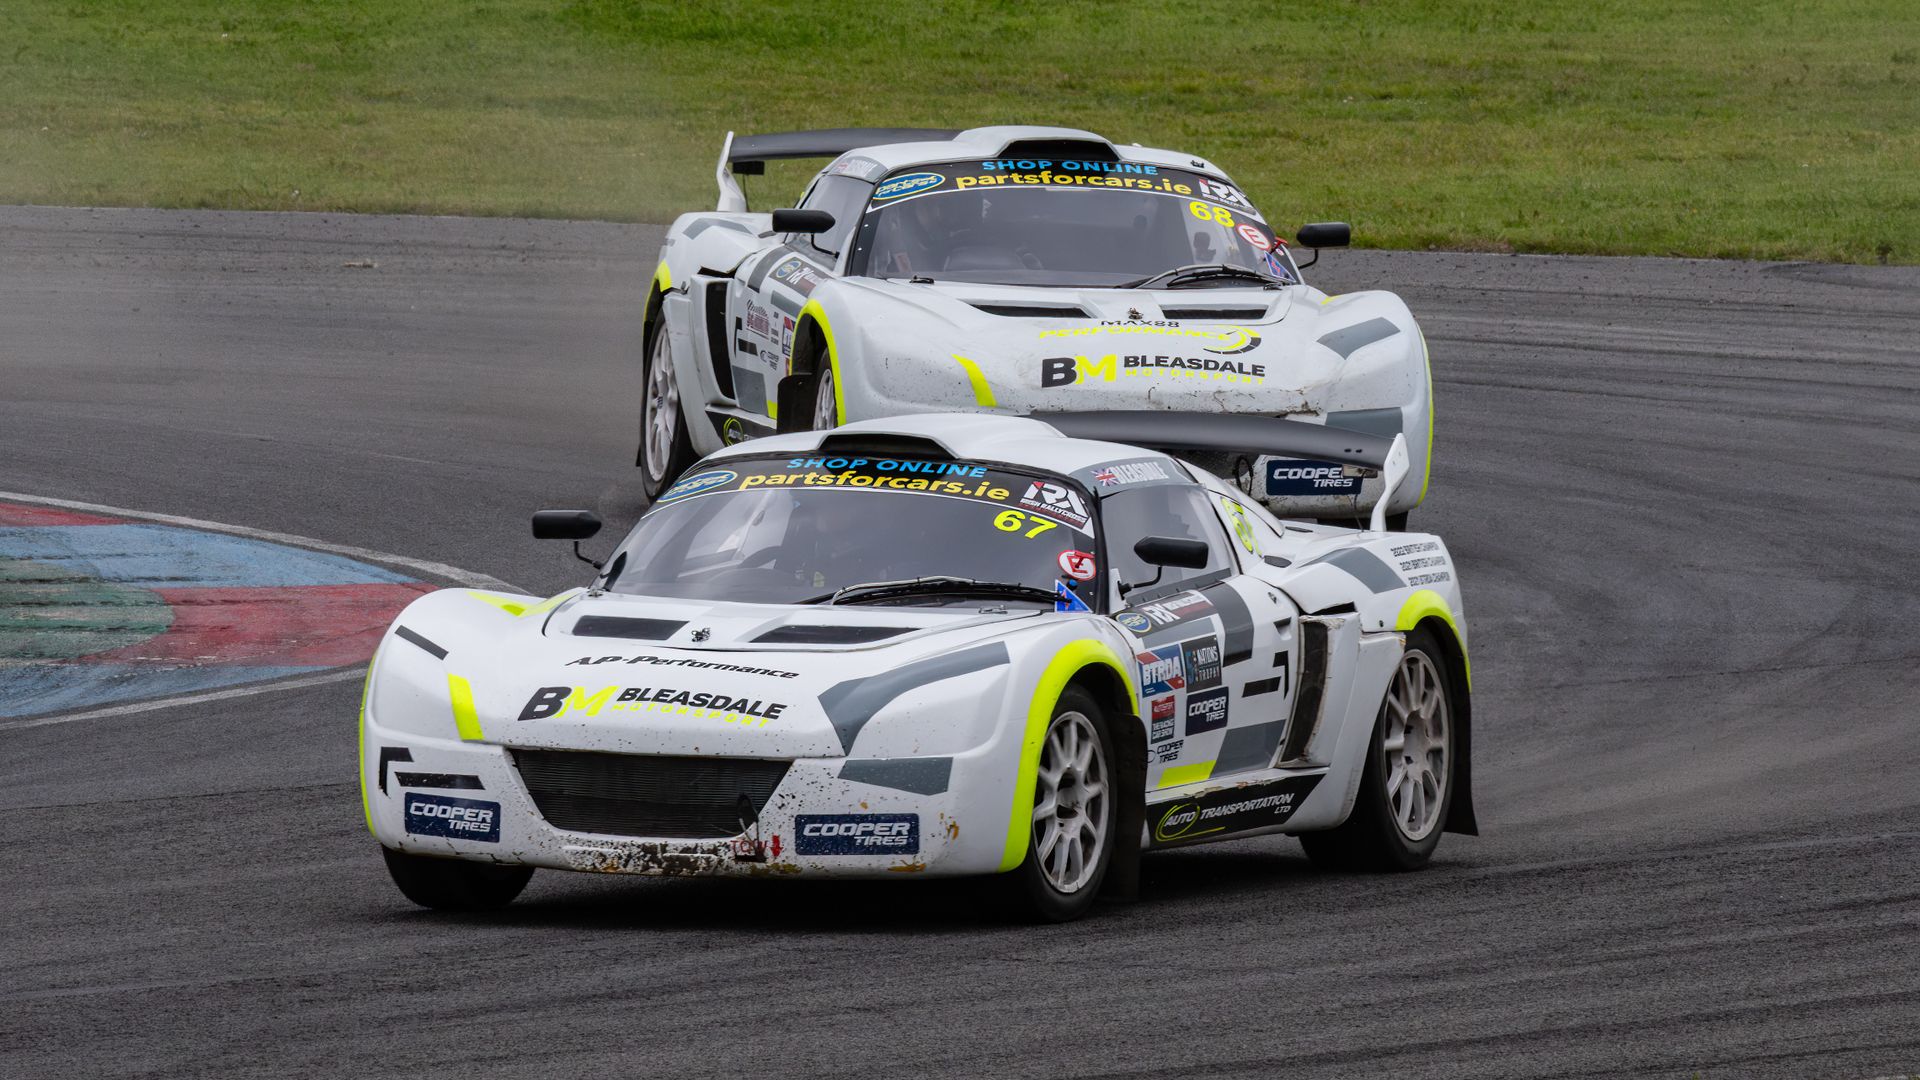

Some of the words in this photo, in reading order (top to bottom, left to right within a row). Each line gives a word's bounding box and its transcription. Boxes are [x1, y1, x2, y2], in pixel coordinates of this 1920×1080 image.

[982, 160, 1052, 171] SHOP
[1061, 161, 1159, 176] ONLINE
[956, 170, 1192, 195] partsforcars.ie
[1190, 201, 1234, 228] 68
[1124, 355, 1266, 377] BLEASDALE
[1125, 368, 1265, 385] MOTORSPORT
[786, 458, 868, 470] SHOP
[876, 460, 988, 478] ONLINE
[1273, 467, 1344, 480] COOPE
[738, 470, 1010, 500] partsforcars.ie
[1313, 479, 1354, 488] TIRES
[993, 510, 1058, 539] 67
[565, 655, 800, 679] AP-Performance
[1142, 656, 1182, 686] BTRDA
[616, 687, 788, 720] BLEASDALE
[1188, 696, 1227, 717] COOPER
[611, 702, 771, 728] MOTORSPORT
[1206, 709, 1225, 722] TIRES
[1156, 740, 1184, 754] COOPER
[1159, 751, 1179, 763] TIRES
[409, 802, 494, 823] COOPER
[1164, 811, 1196, 827] AUTO
[1200, 793, 1295, 820] TRANSPORTATION
[1274, 805, 1292, 814] LTD
[448, 819, 491, 832] TIRES
[803, 823, 911, 836] COOPER
[853, 835, 909, 846] TIRES
